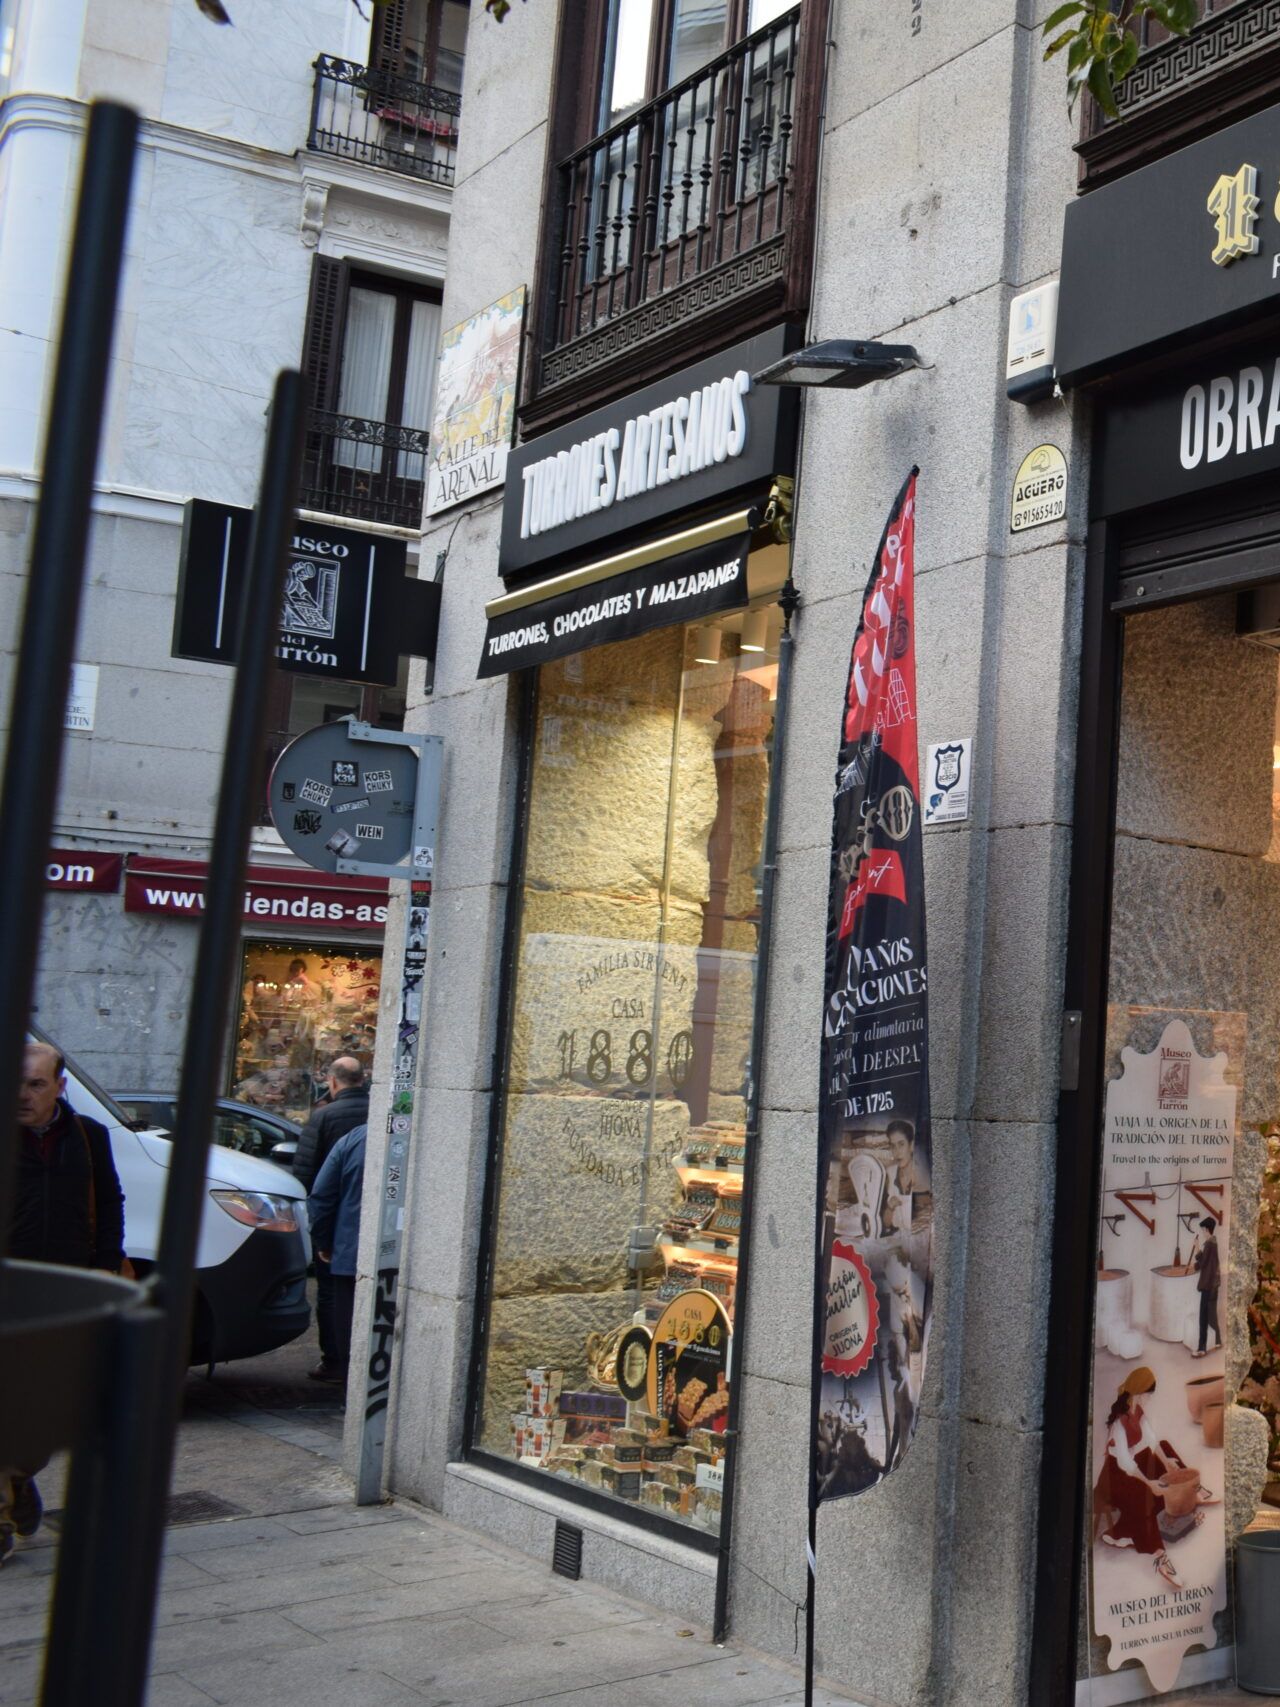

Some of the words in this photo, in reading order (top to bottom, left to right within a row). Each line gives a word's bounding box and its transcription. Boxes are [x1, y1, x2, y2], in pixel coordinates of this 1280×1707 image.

[520, 427, 619, 540] TURRONES
[617, 370, 750, 501] ARTESANOS
[433, 451, 500, 508] ARENAL
[488, 621, 549, 657] TURRONES,
[554, 592, 631, 638] CHOCOLATES
[635, 588, 645, 611] Y
[649, 558, 740, 607] MAZAPANES
[364, 771, 391, 782] KORS
[306, 780, 332, 797] KORS
[366, 780, 393, 792] CHUKY
[302, 789, 328, 806] CHUKY
[358, 825, 383, 839] WEIN
[577, 951, 628, 995] FAMILIA
[612, 998, 645, 1019] CASA
[556, 1028, 694, 1090] 1880
[1160, 1047, 1192, 1059] Museo
[866, 1090, 895, 1114] 1725
[1157, 1099, 1188, 1110] Turrón
[1114, 1116, 1140, 1127] VIAJA
[1144, 1117, 1156, 1127] AL
[1160, 1117, 1198, 1129] ORIGEN
[1200, 1118, 1214, 1129] DE
[1215, 1119, 1228, 1129] LA
[1111, 1130, 1166, 1144] TRADICIÓN
[1168, 1134, 1186, 1144] DEL
[1191, 1132, 1230, 1145] TURRÓN
[1112, 1154, 1136, 1164] Travel
[1138, 1155, 1146, 1164] to
[1148, 1155, 1161, 1164] the
[1163, 1155, 1190, 1167] origins
[1191, 1155, 1200, 1164] of
[1202, 1155, 1227, 1164] Turron
[1108, 1599, 1147, 1616] MUSEO
[1150, 1594, 1167, 1608] DEL
[1173, 1584, 1214, 1603] TURRÓN
[1122, 1615, 1135, 1628] EN
[1138, 1613, 1150, 1624] EL
[1154, 1602, 1201, 1622] INTERIOR
